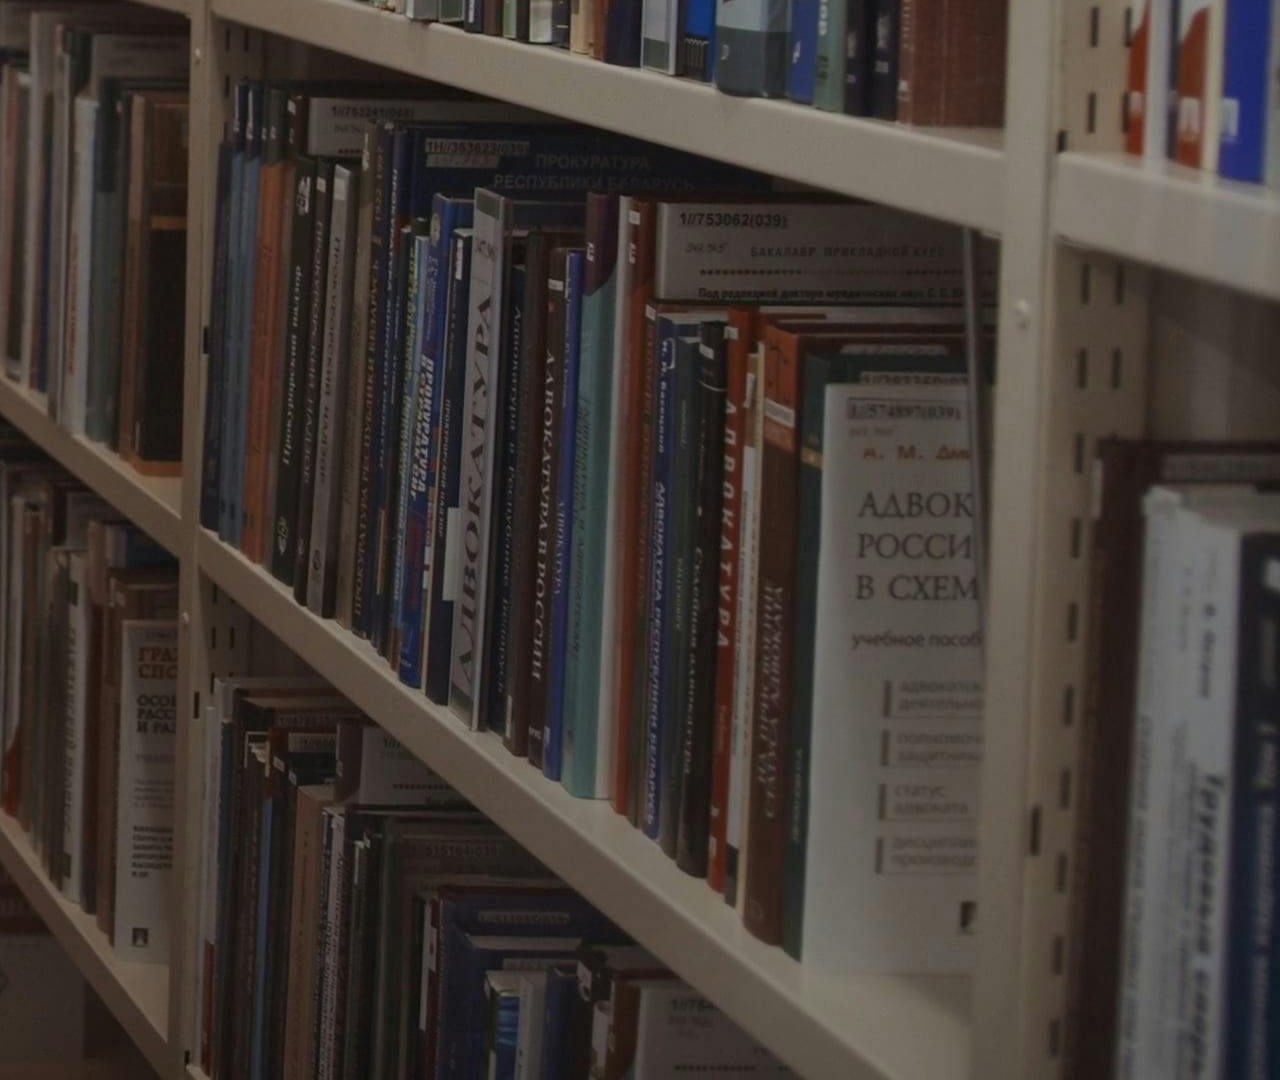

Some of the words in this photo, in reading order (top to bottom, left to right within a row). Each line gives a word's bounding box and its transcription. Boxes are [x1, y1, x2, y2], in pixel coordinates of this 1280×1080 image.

[493, 174, 601, 191] РЕСПУБЛИКИ
[607, 175, 696, 191] БЕЛАРУСЬ
[535, 153, 649, 170] ПРОКУРАТУРА
[679, 212, 788, 229] 1//753062(039)
[823, 246, 909, 258] ПРИКЛАДНОЙ
[913, 246, 945, 258] КУРС
[305, 220, 324, 384] ПРОКУРОРСКИЙ
[323, 236, 341, 395] ПРОКУРОРСКИЙ
[698, 287, 719, 299] Под
[721, 288, 779, 300] редакцией
[781, 289, 825, 300] доктора
[282, 335, 299, 466] Прокурорский
[291, 266, 303, 329] надзор
[303, 397, 315, 485] НАДЗОР
[318, 406, 334, 485] НАДЗОР
[417, 355, 435, 494] ПРОКУРАТУРА
[538, 349, 555, 530] АДВОКАТУРА
[897, 445, 924, 459] М.
[458, 295, 490, 681] АДВОКАТУРА
[717, 399, 737, 648] АДВОКАТУРА
[653, 481, 666, 599] АДВОКАТУРА
[856, 532, 973, 561] РОССИ
[531, 558, 546, 681] РОССИИ
[687, 546, 704, 669] Судебная
[854, 575, 874, 601] В
[650, 605, 662, 729] РЕСПУБЛИКИ
[768, 585, 784, 705] АДВОКАТА
[850, 633, 925, 653] учебное
[683, 678, 698, 775] адвокатура
[765, 717, 779, 819] СТАТУСА
[646, 733, 658, 825] БЕЛАРУСЬ
[893, 784, 945, 799] статус
[893, 801, 968, 816] адвоката
